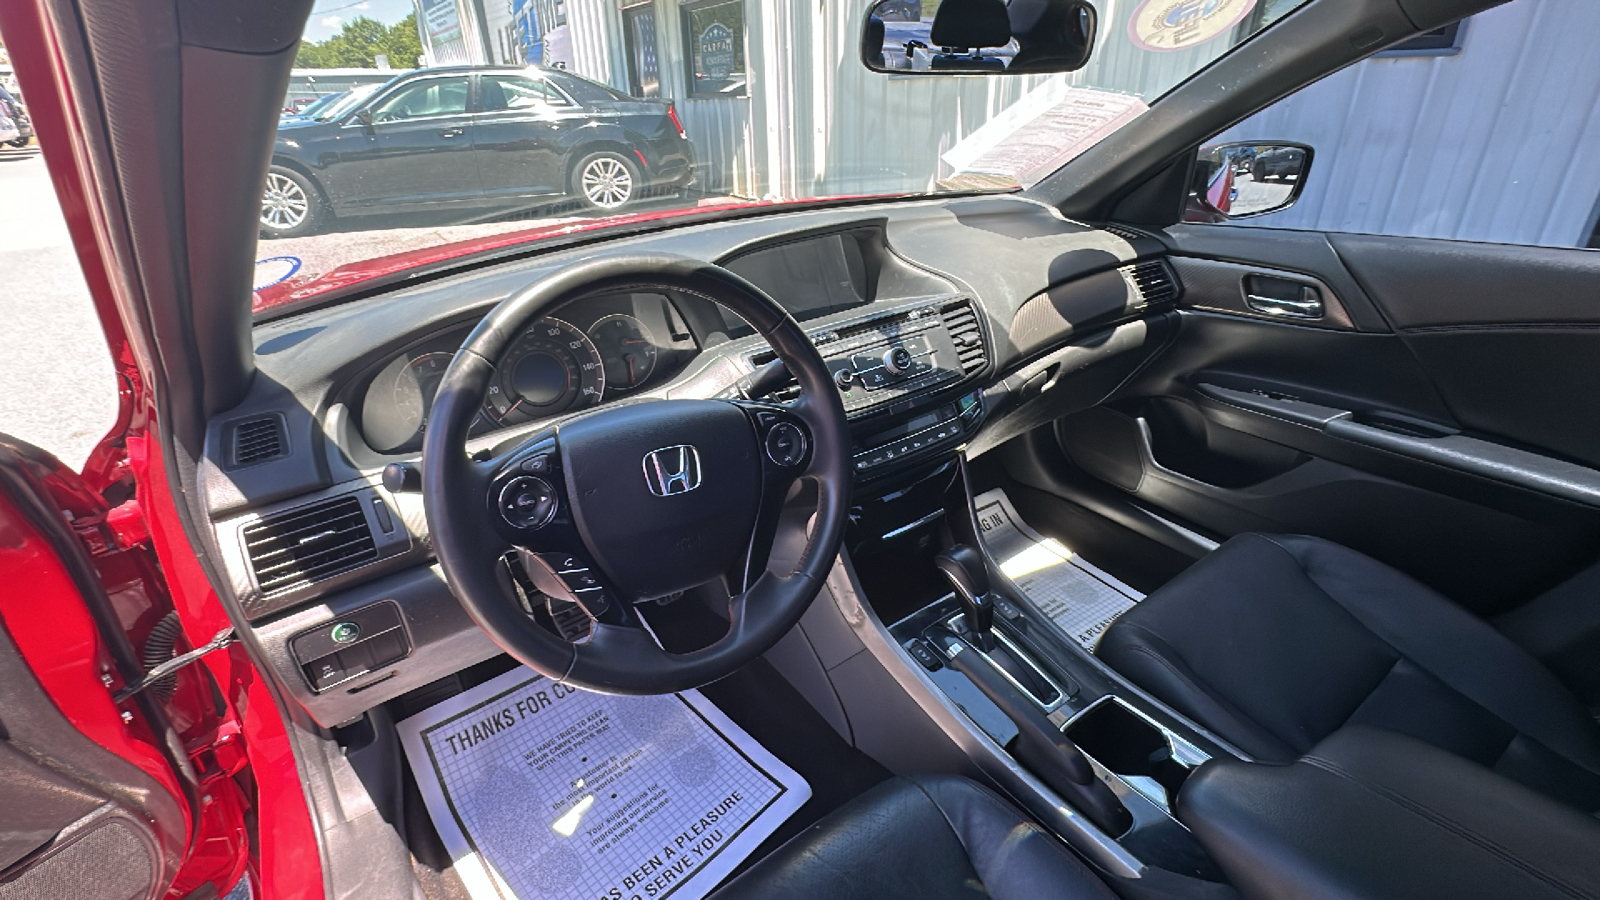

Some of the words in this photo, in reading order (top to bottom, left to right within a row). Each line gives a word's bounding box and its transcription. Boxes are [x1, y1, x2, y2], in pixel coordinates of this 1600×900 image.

[547, 328, 561, 337] 100
[569, 341, 582, 350] 120
[582, 363, 596, 371] 140
[489, 386, 499, 394] 20
[582, 387, 595, 396] 160
[990, 512, 1004, 527] IN
[445, 708, 516, 755] THANKS
[515, 690, 553, 720] FOR
[523, 749, 537, 761] WE
[536, 738, 557, 754] HAVE
[555, 725, 578, 741] TRIED
[576, 719, 588, 729] TO
[586, 709, 603, 722] KEEP
[528, 752, 549, 768] YOUR
[549, 728, 588, 755] CARPETING
[587, 715, 610, 732] CLEAN
[535, 757, 557, 771] WITH
[556, 746, 574, 759] THIS
[573, 732, 596, 749] PAPER
[552, 799, 566, 811] the
[566, 786, 585, 801] most
[585, 763, 621, 788] important
[620, 748, 643, 767] person
[614, 771, 624, 780] to
[586, 822, 605, 837] Your
[605, 790, 649, 824] suggestions
[647, 783, 659, 793] for
[590, 817, 629, 847] improving
[628, 807, 641, 819] our
[641, 788, 667, 809] service
[597, 842, 611, 854] are
[611, 821, 638, 844] always
[622, 854, 664, 891] BEEN
[663, 845, 677, 860] A
[674, 790, 744, 849] PLEASURE
[644, 854, 694, 897] SERVE
[692, 829, 724, 858] YOU
